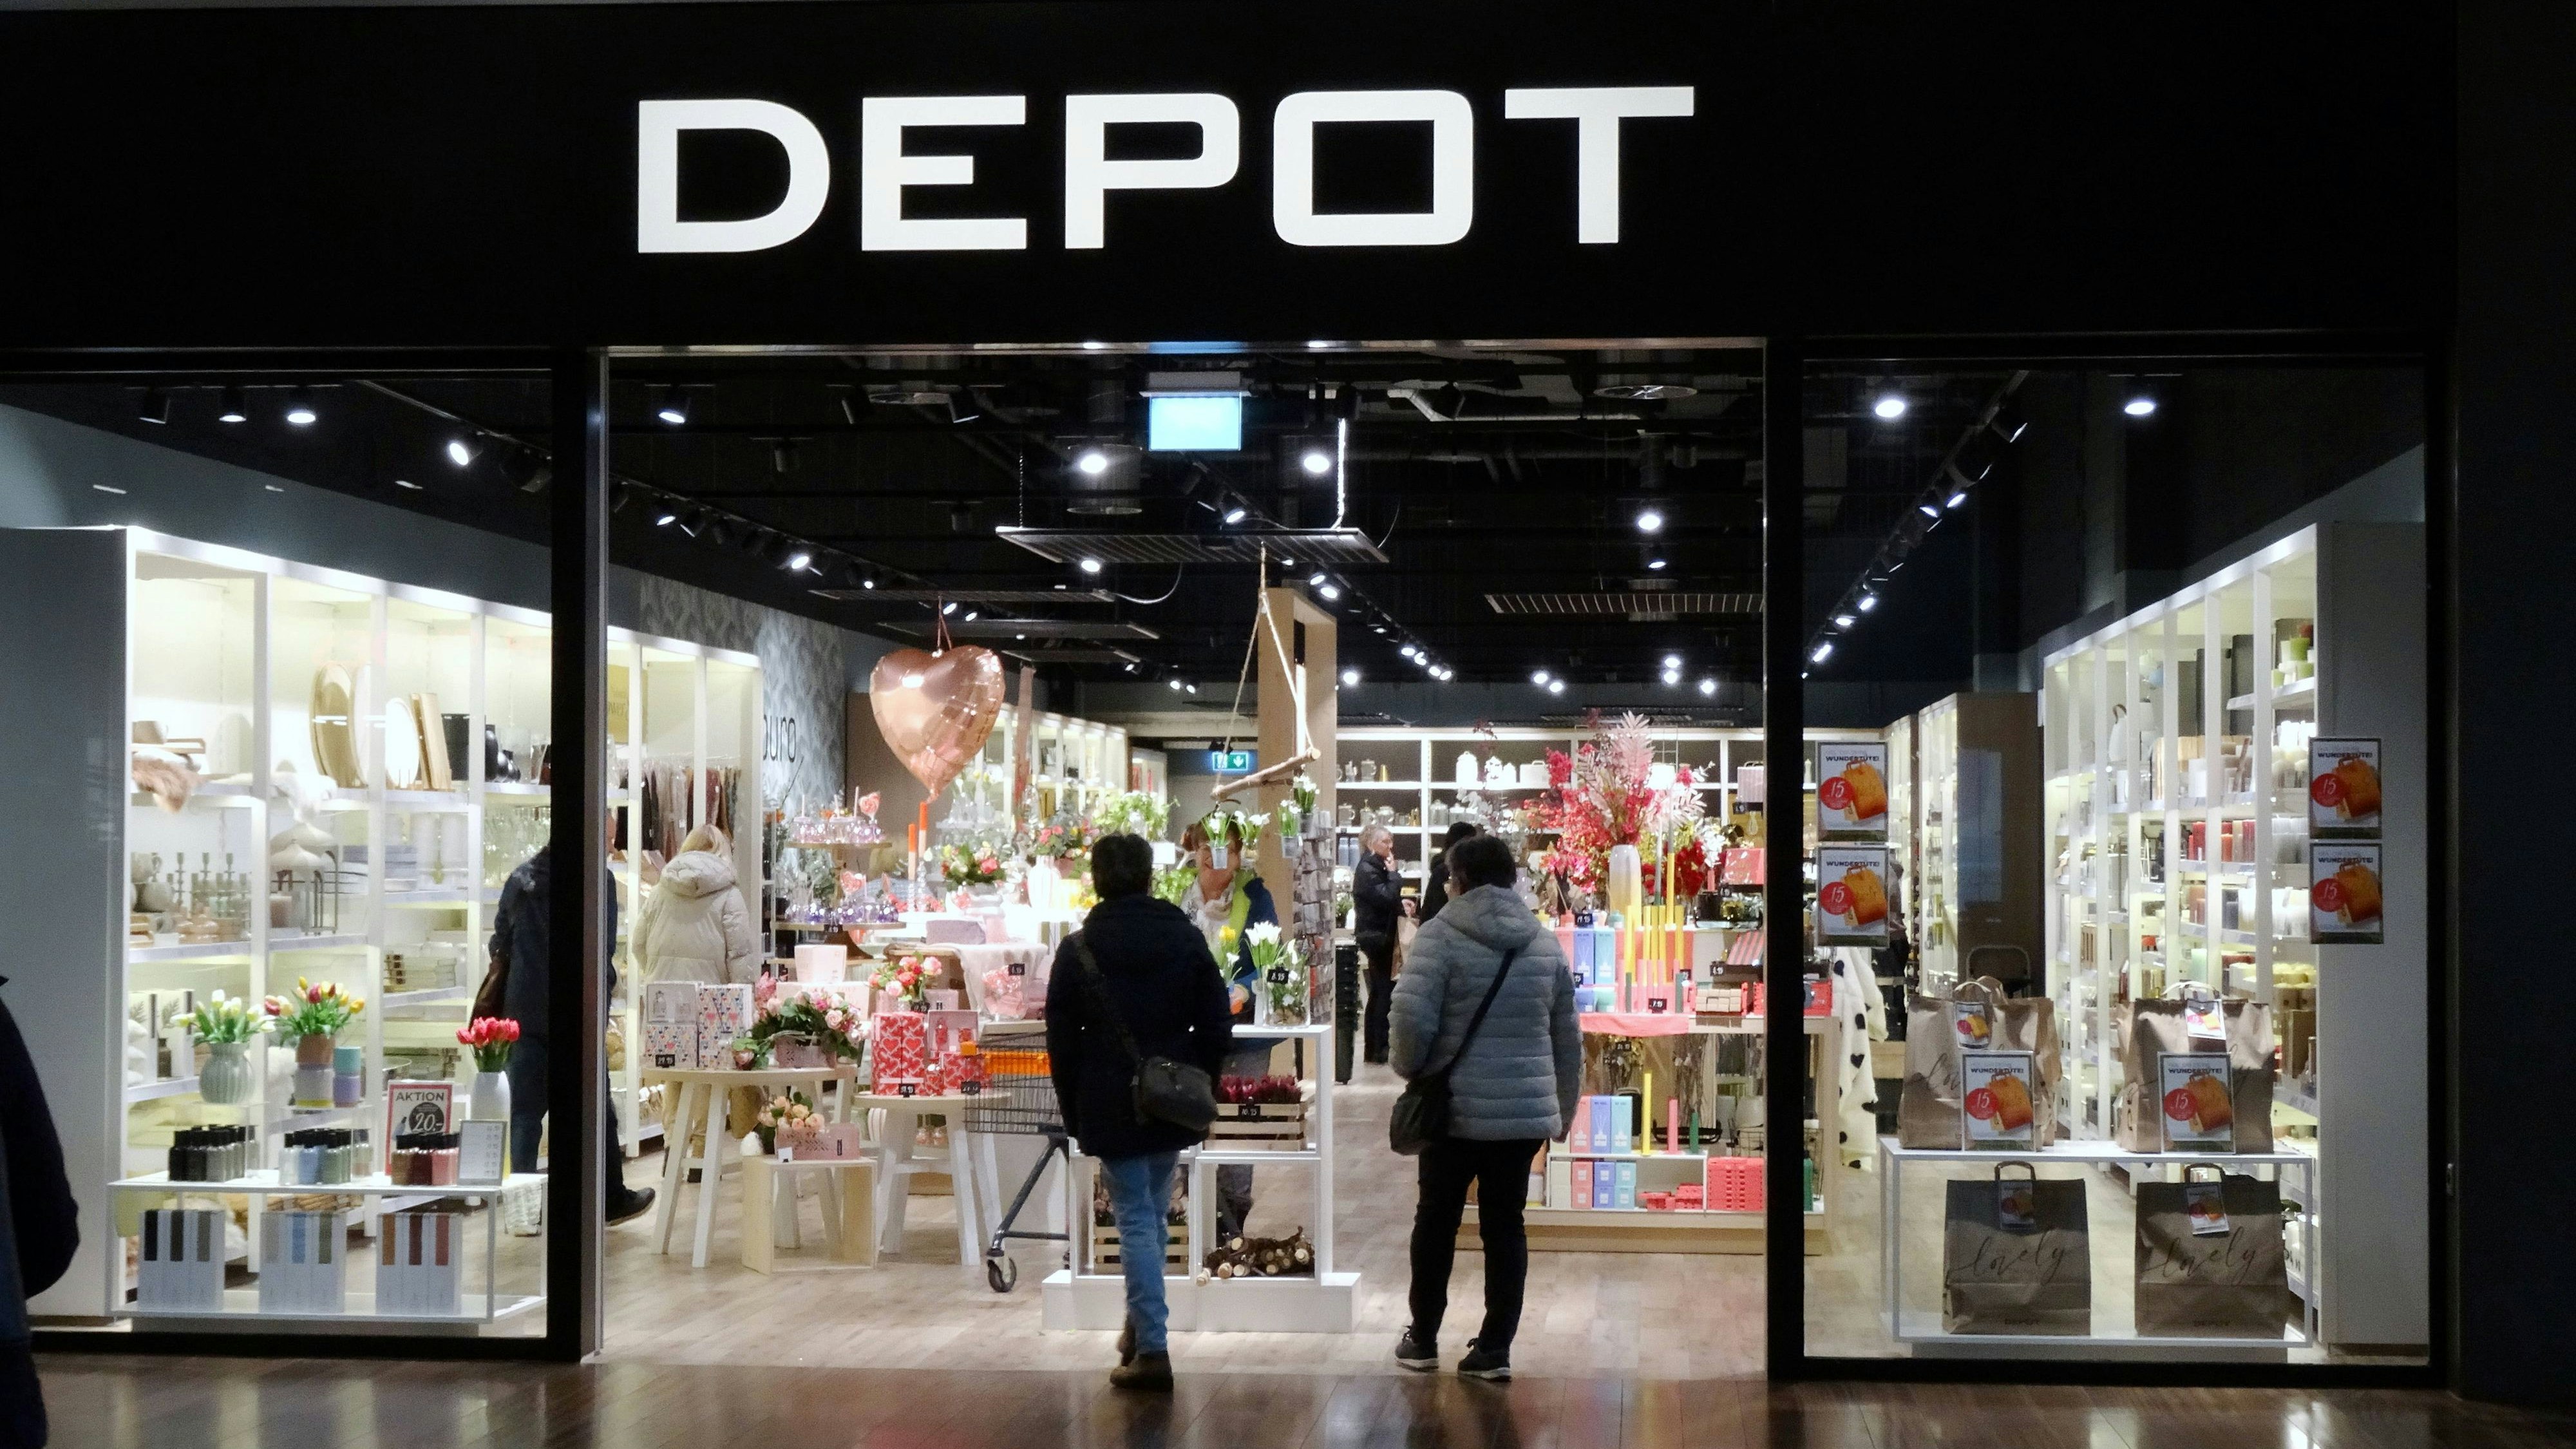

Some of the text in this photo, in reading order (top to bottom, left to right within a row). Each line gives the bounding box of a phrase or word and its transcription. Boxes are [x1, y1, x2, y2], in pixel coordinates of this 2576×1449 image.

[637, 86, 1695, 254] DEPOT
[1830, 780, 1845, 798] 15
[2323, 777, 2336, 795] 15
[1832, 886, 1845, 903] 15
[2323, 882, 2338, 900] 15
[395, 1092, 444, 1101] AKTION
[1976, 1092, 1990, 1108] 15
[2175, 1093, 2189, 1110] 15
